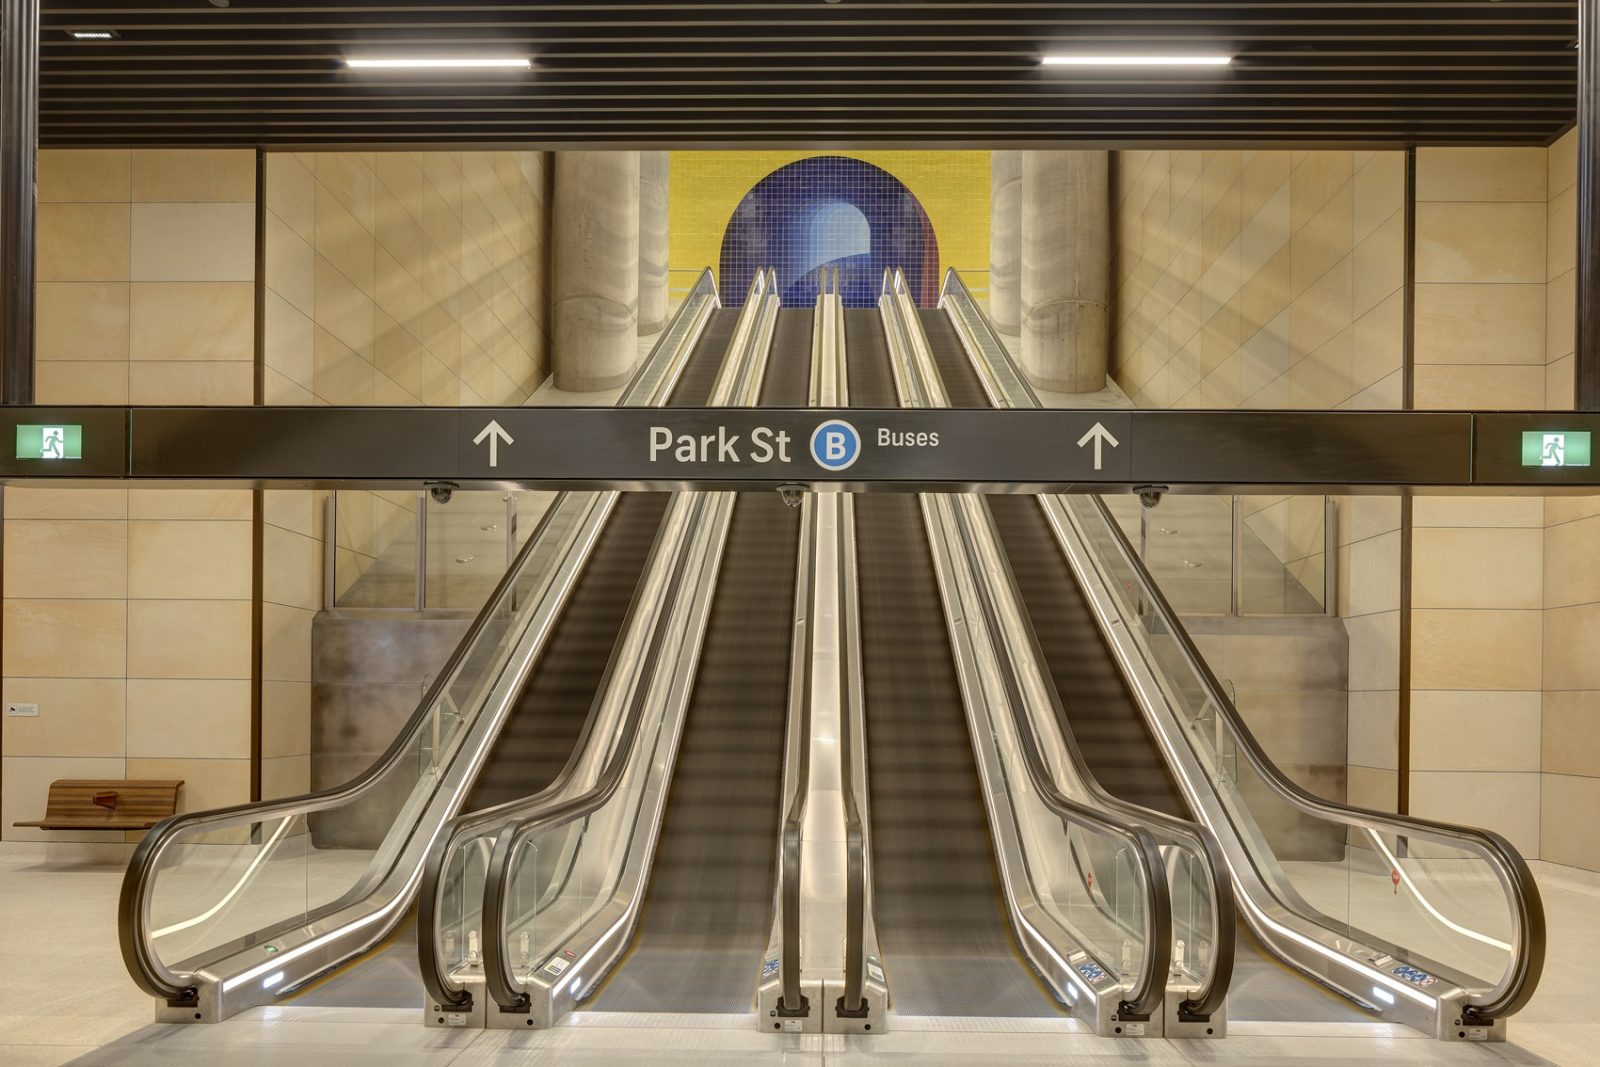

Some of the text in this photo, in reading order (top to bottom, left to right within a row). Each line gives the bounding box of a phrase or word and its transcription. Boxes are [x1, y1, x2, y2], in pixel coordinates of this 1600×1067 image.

[649, 426, 939, 463] Park St B Buses
